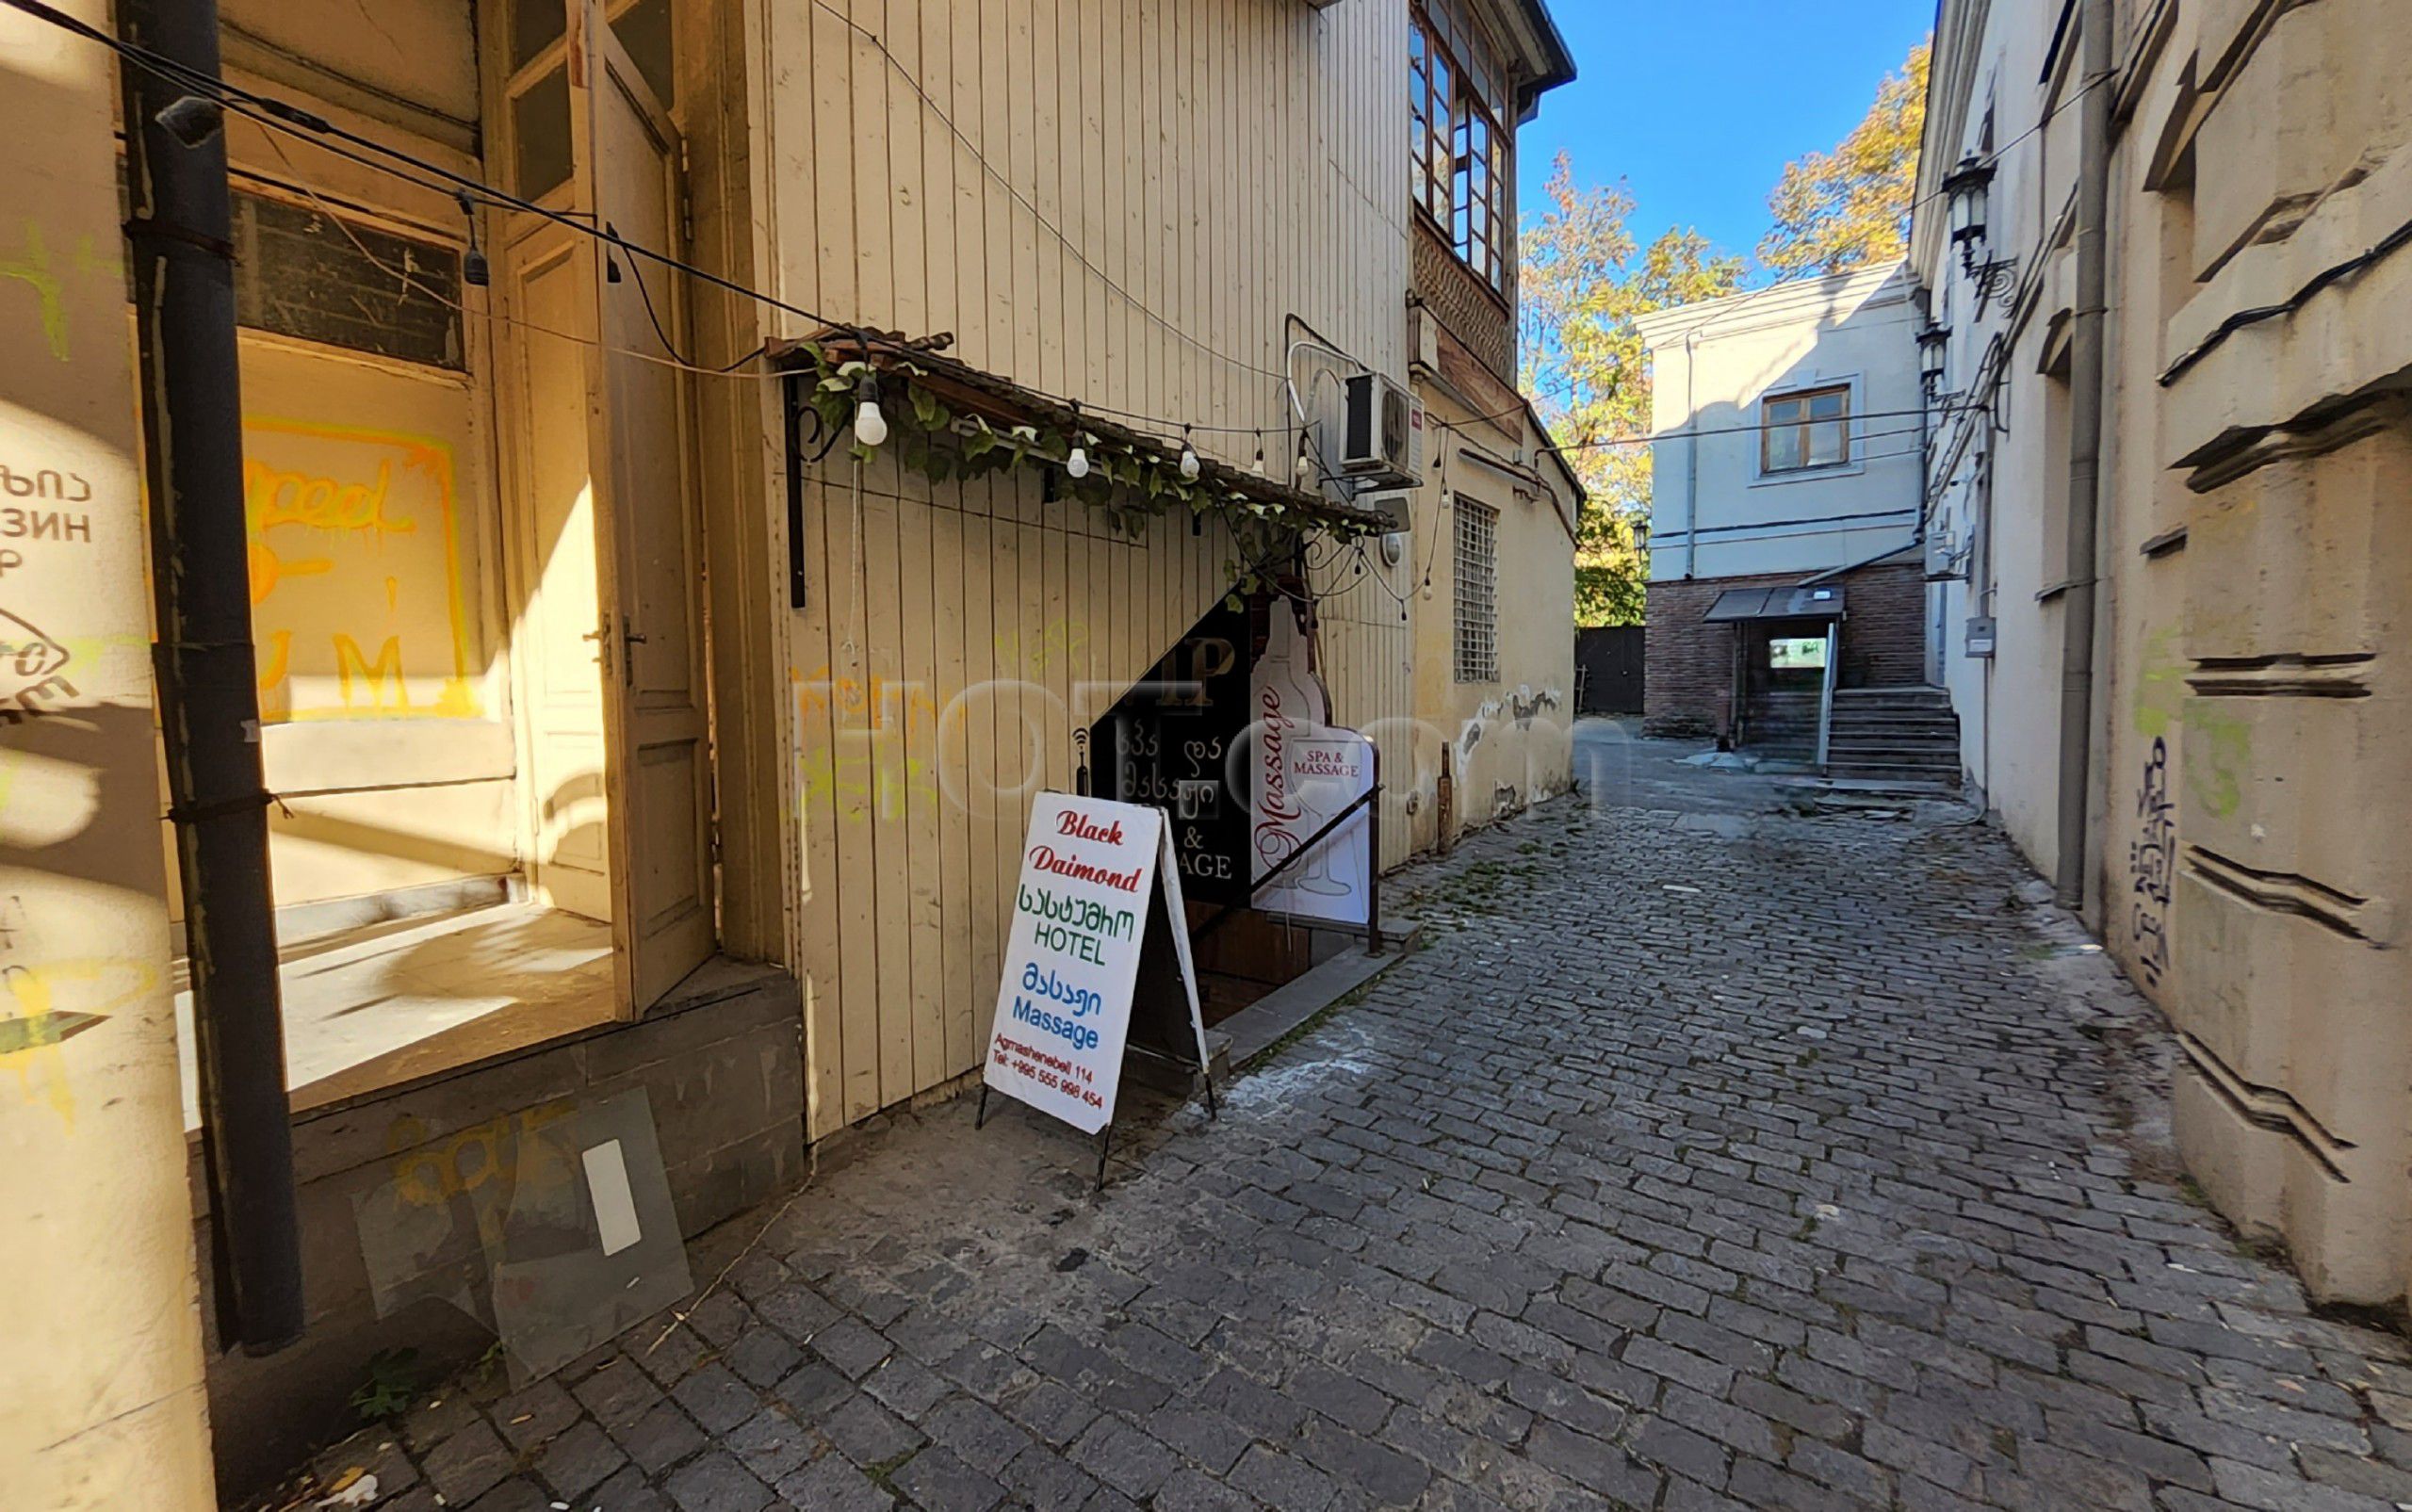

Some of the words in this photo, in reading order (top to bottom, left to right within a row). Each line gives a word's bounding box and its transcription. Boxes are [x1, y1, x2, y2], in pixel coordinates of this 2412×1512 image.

[1294, 761, 1360, 777] MASSAGE
[1307, 749, 1331, 763] SPA
[1334, 751, 1345, 763] &
[1254, 686, 1302, 871] Massage
[1056, 810, 1124, 846] Black
[1183, 825, 1205, 851] &
[1029, 845, 1143, 893] Daimond
[1019, 883, 1135, 943] სასტუმრო
[1035, 921, 1106, 967] HOTEL
[1022, 962, 1102, 1017] მასაჟი
[1013, 995, 1100, 1050] Massage
[1037, 1069, 1058, 1089] 555
[1082, 1090, 1103, 1110] 454
[1076, 1065, 1094, 1084] 114
